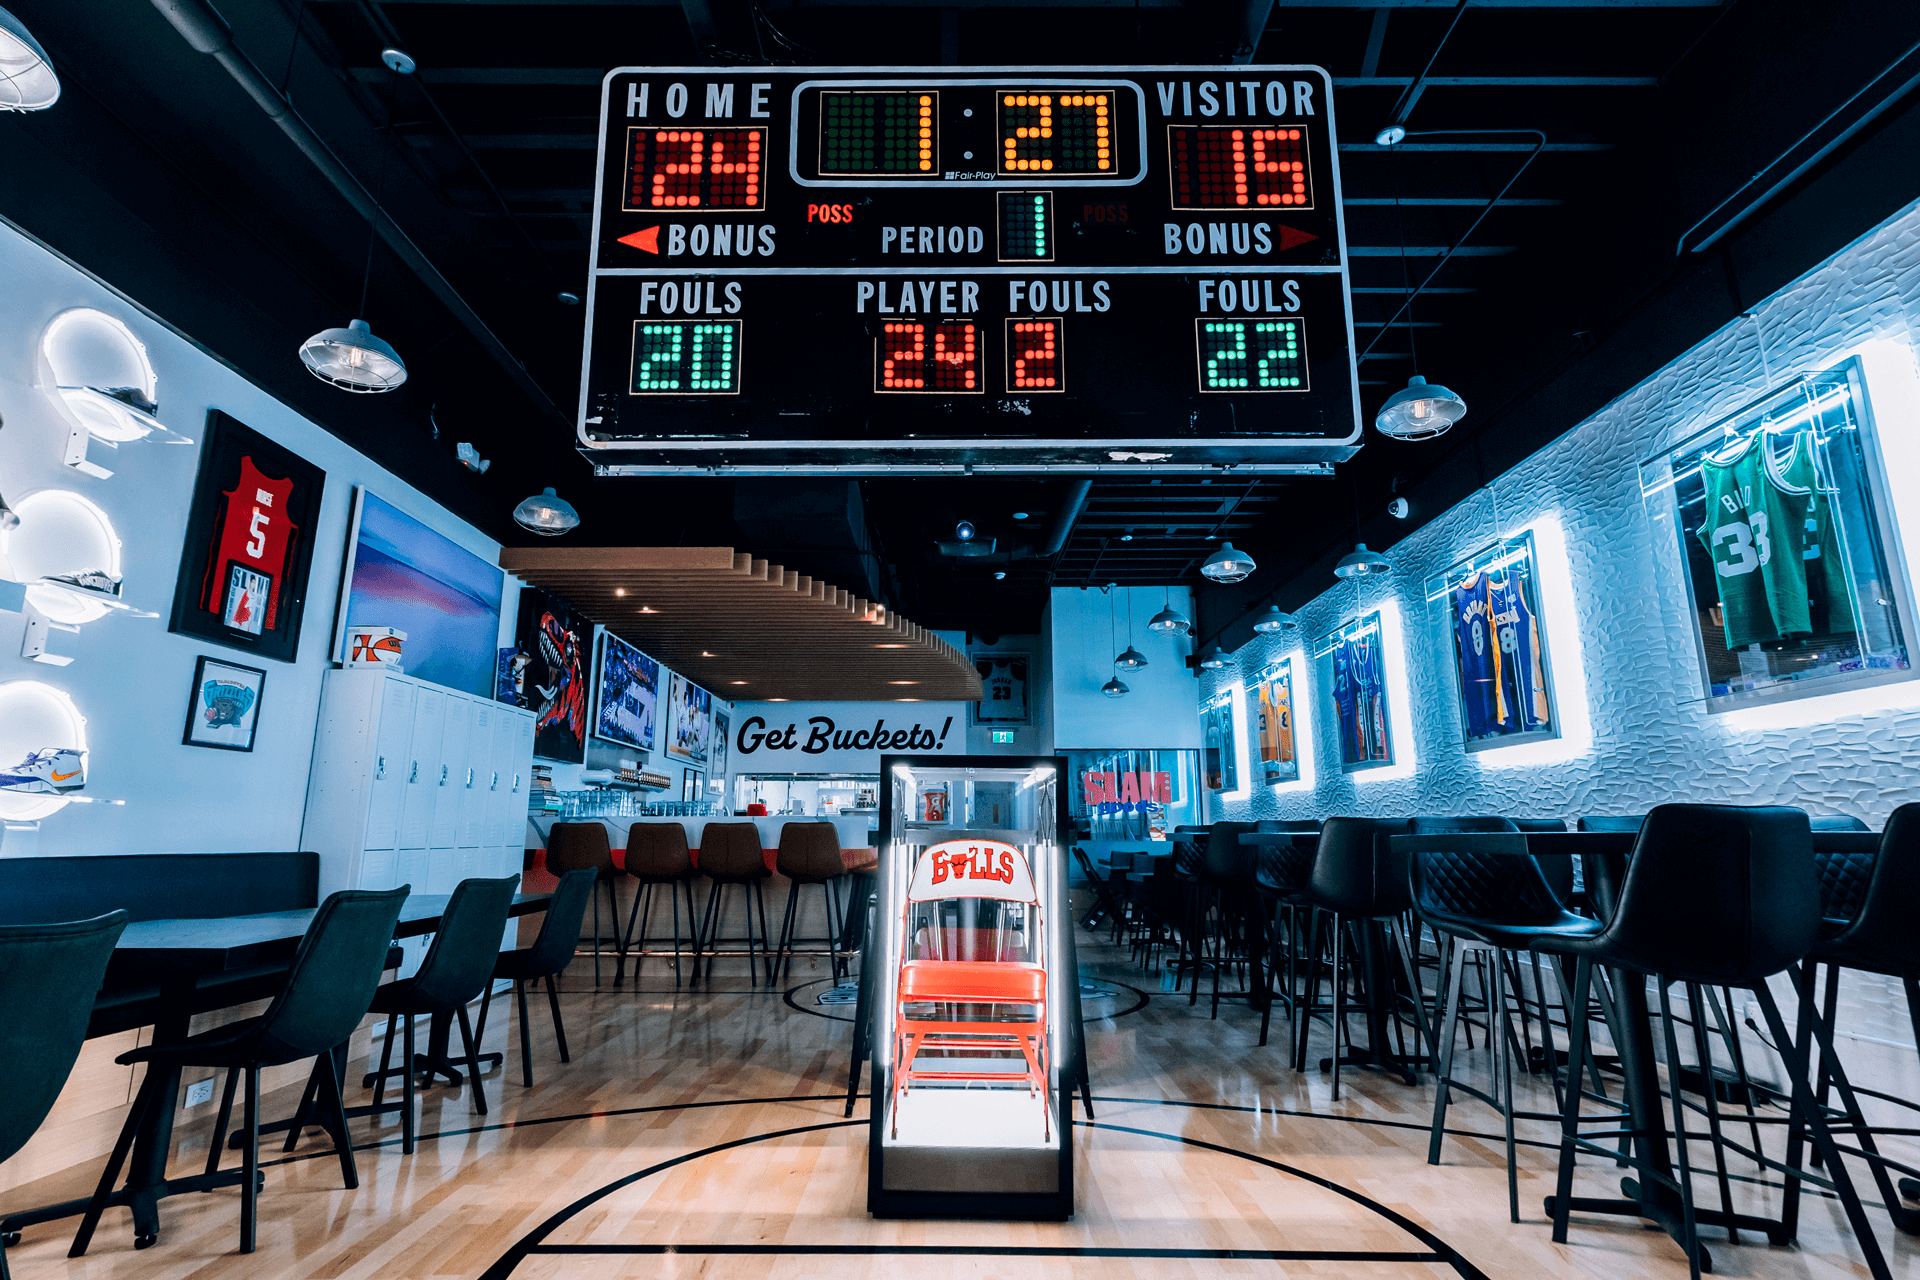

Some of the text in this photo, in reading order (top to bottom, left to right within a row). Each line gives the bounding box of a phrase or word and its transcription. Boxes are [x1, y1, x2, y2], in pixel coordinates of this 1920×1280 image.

[626, 83, 771, 118] HOME
[1157, 81, 1315, 116] VISITOR
[651, 131, 761, 206] 24
[955, 171, 996, 180] Fair-Play
[1231, 129, 1306, 205] 15
[808, 204, 853, 223] POSS
[1083, 204, 1129, 223] POSS
[668, 224, 776, 256] BONUS
[882, 226, 984, 254] PERIOD
[1164, 223, 1272, 255] BONUS
[640, 281, 742, 314] FOULS
[857, 280, 1111, 313] PLAYER FOULS
[1199, 279, 1300, 312] FOULS
[639, 324, 734, 390] 20
[883, 323, 975, 389] 24
[1014, 322, 1056, 388] 2
[1205, 322, 1300, 388] 22
[246, 511, 270, 559] 5
[1712, 511, 1771, 577] 33
[1500, 627, 1517, 654] 8
[992, 686, 1012, 700] 23
[737, 716, 954, 755] Get Buckets!
[1084, 771, 1172, 805] SLAM
